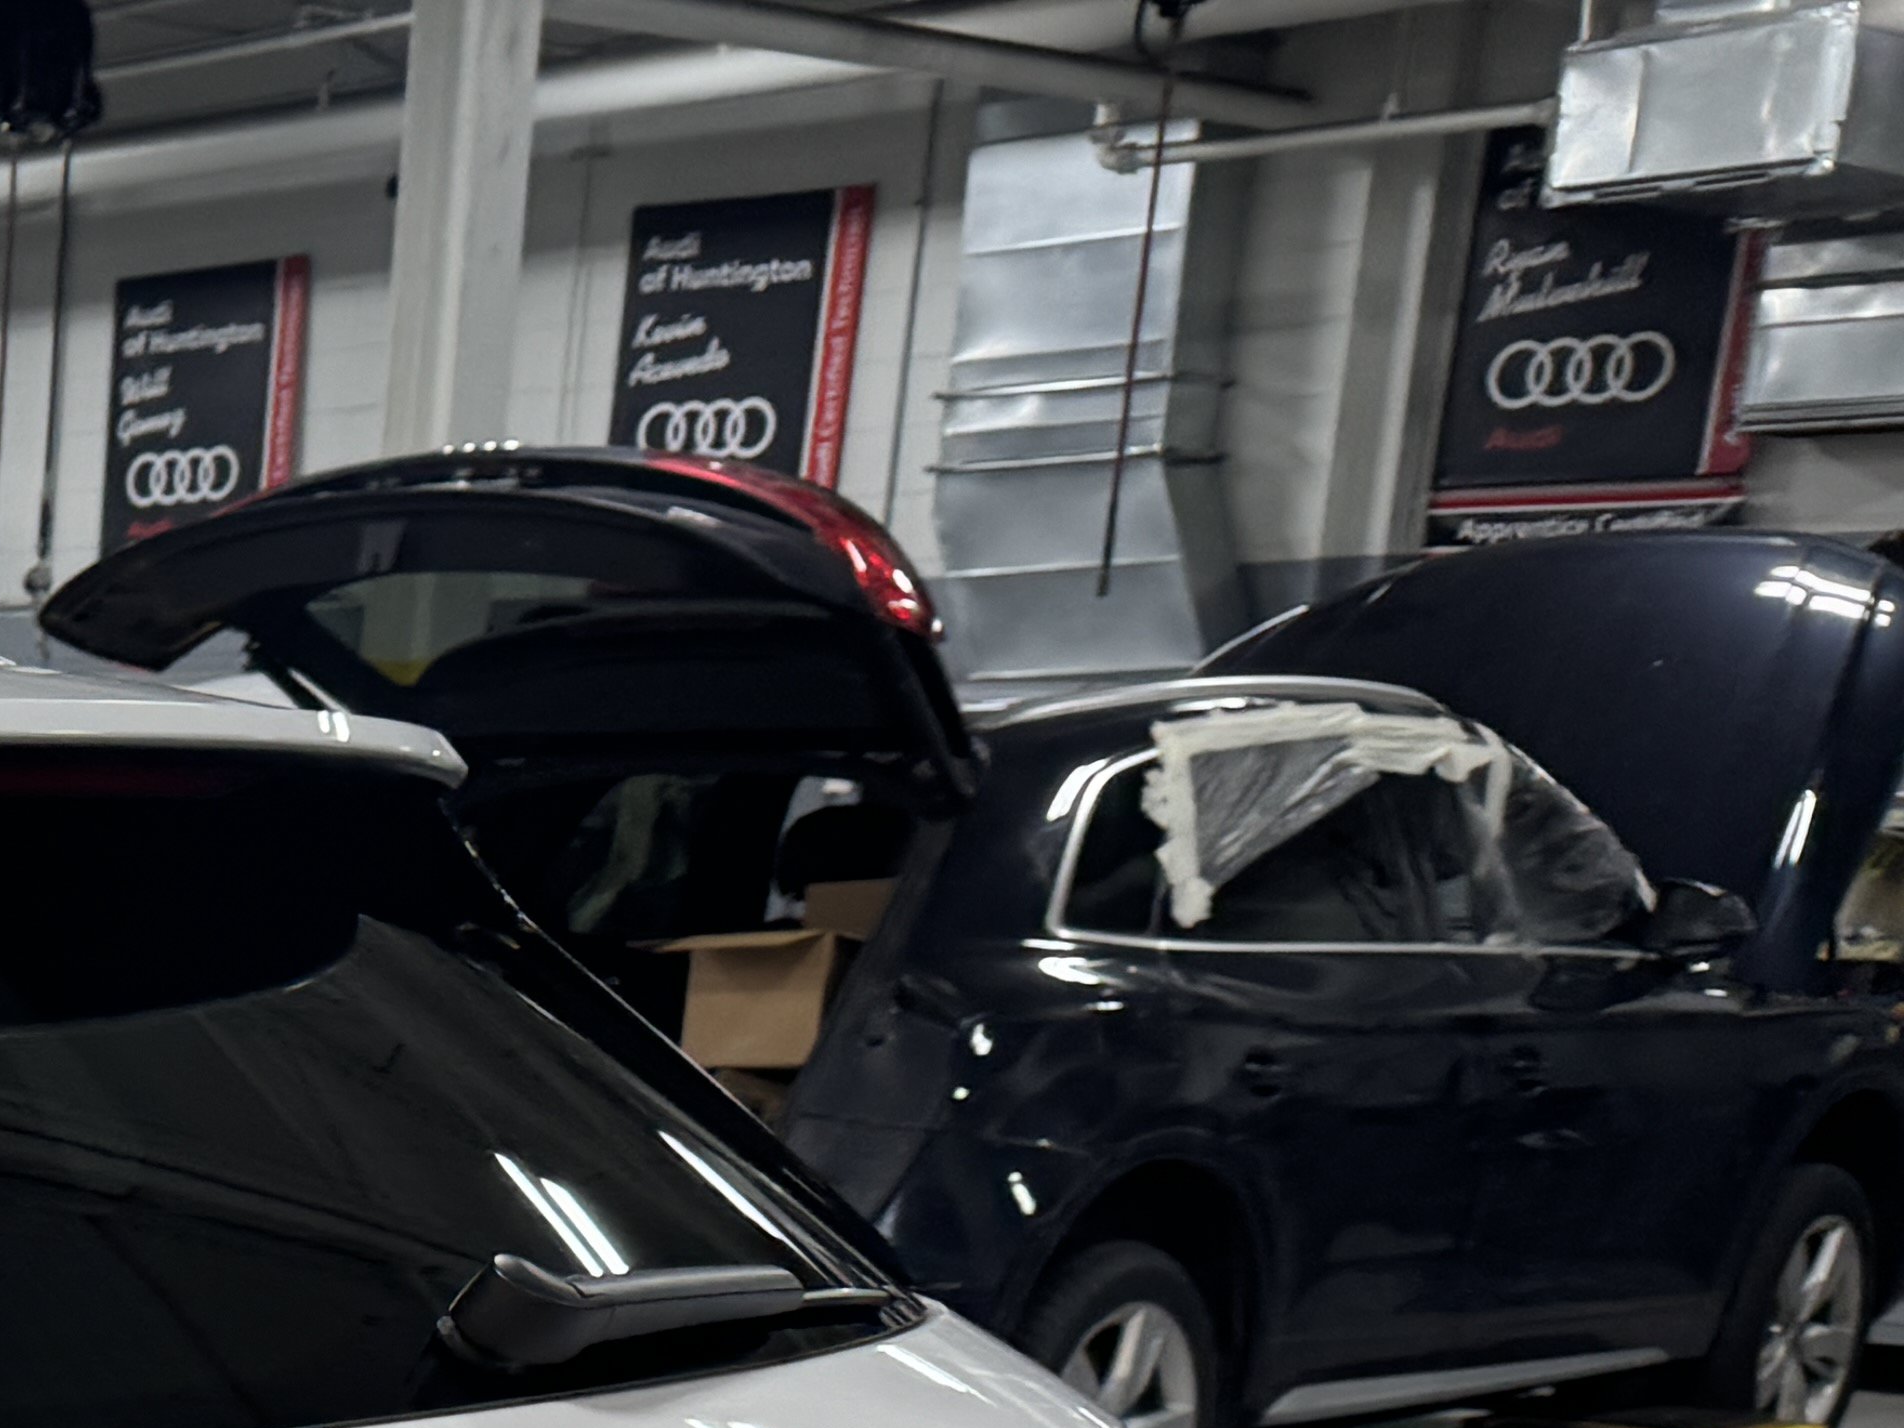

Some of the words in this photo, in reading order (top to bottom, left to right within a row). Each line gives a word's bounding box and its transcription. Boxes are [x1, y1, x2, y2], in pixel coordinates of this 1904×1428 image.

[643, 231, 702, 262] Audi
[639, 263, 669, 295] of
[669, 259, 814, 293] Huntington
[124, 299, 174, 330] Audi
